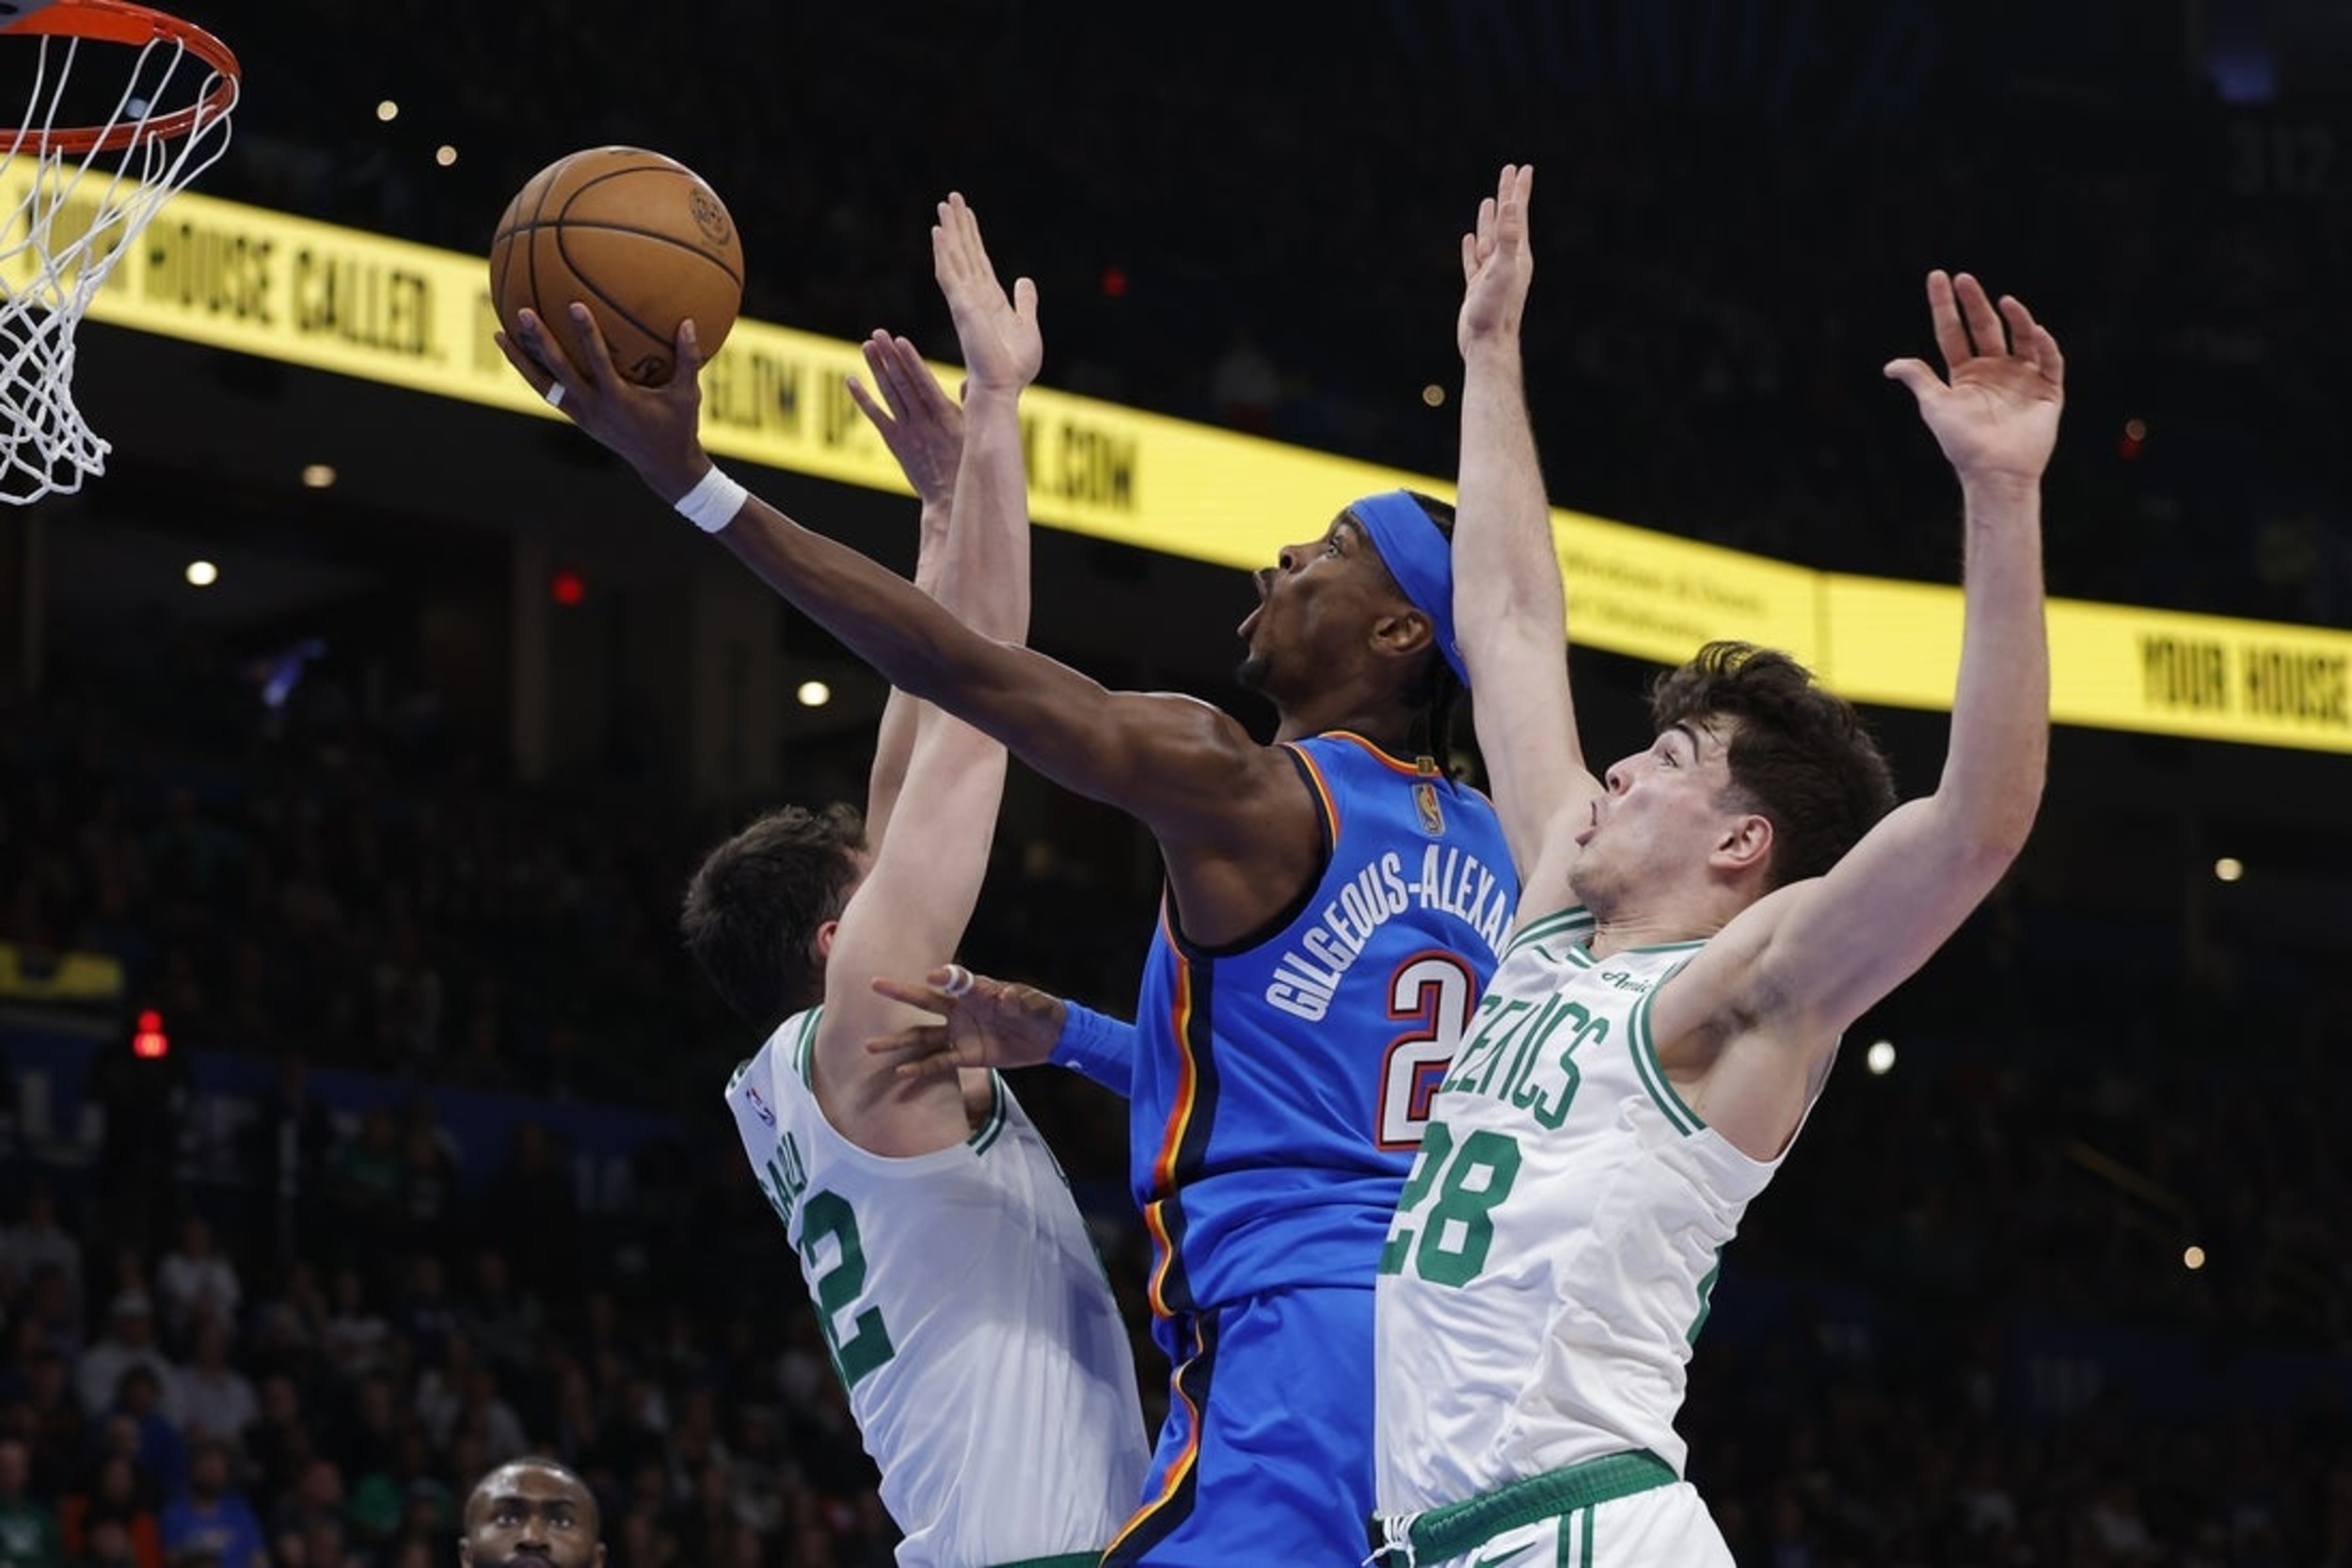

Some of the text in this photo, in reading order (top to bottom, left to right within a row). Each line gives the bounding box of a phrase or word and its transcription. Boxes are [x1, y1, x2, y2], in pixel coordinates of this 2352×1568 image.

[142, 220, 276, 326] HOUSE
[2140, 635, 2349, 728] YOUR HOUSE
[1375, 949, 1477, 1153] 2
[1376, 1120, 1523, 1289] 28
[796, 1189, 896, 1390] 2
